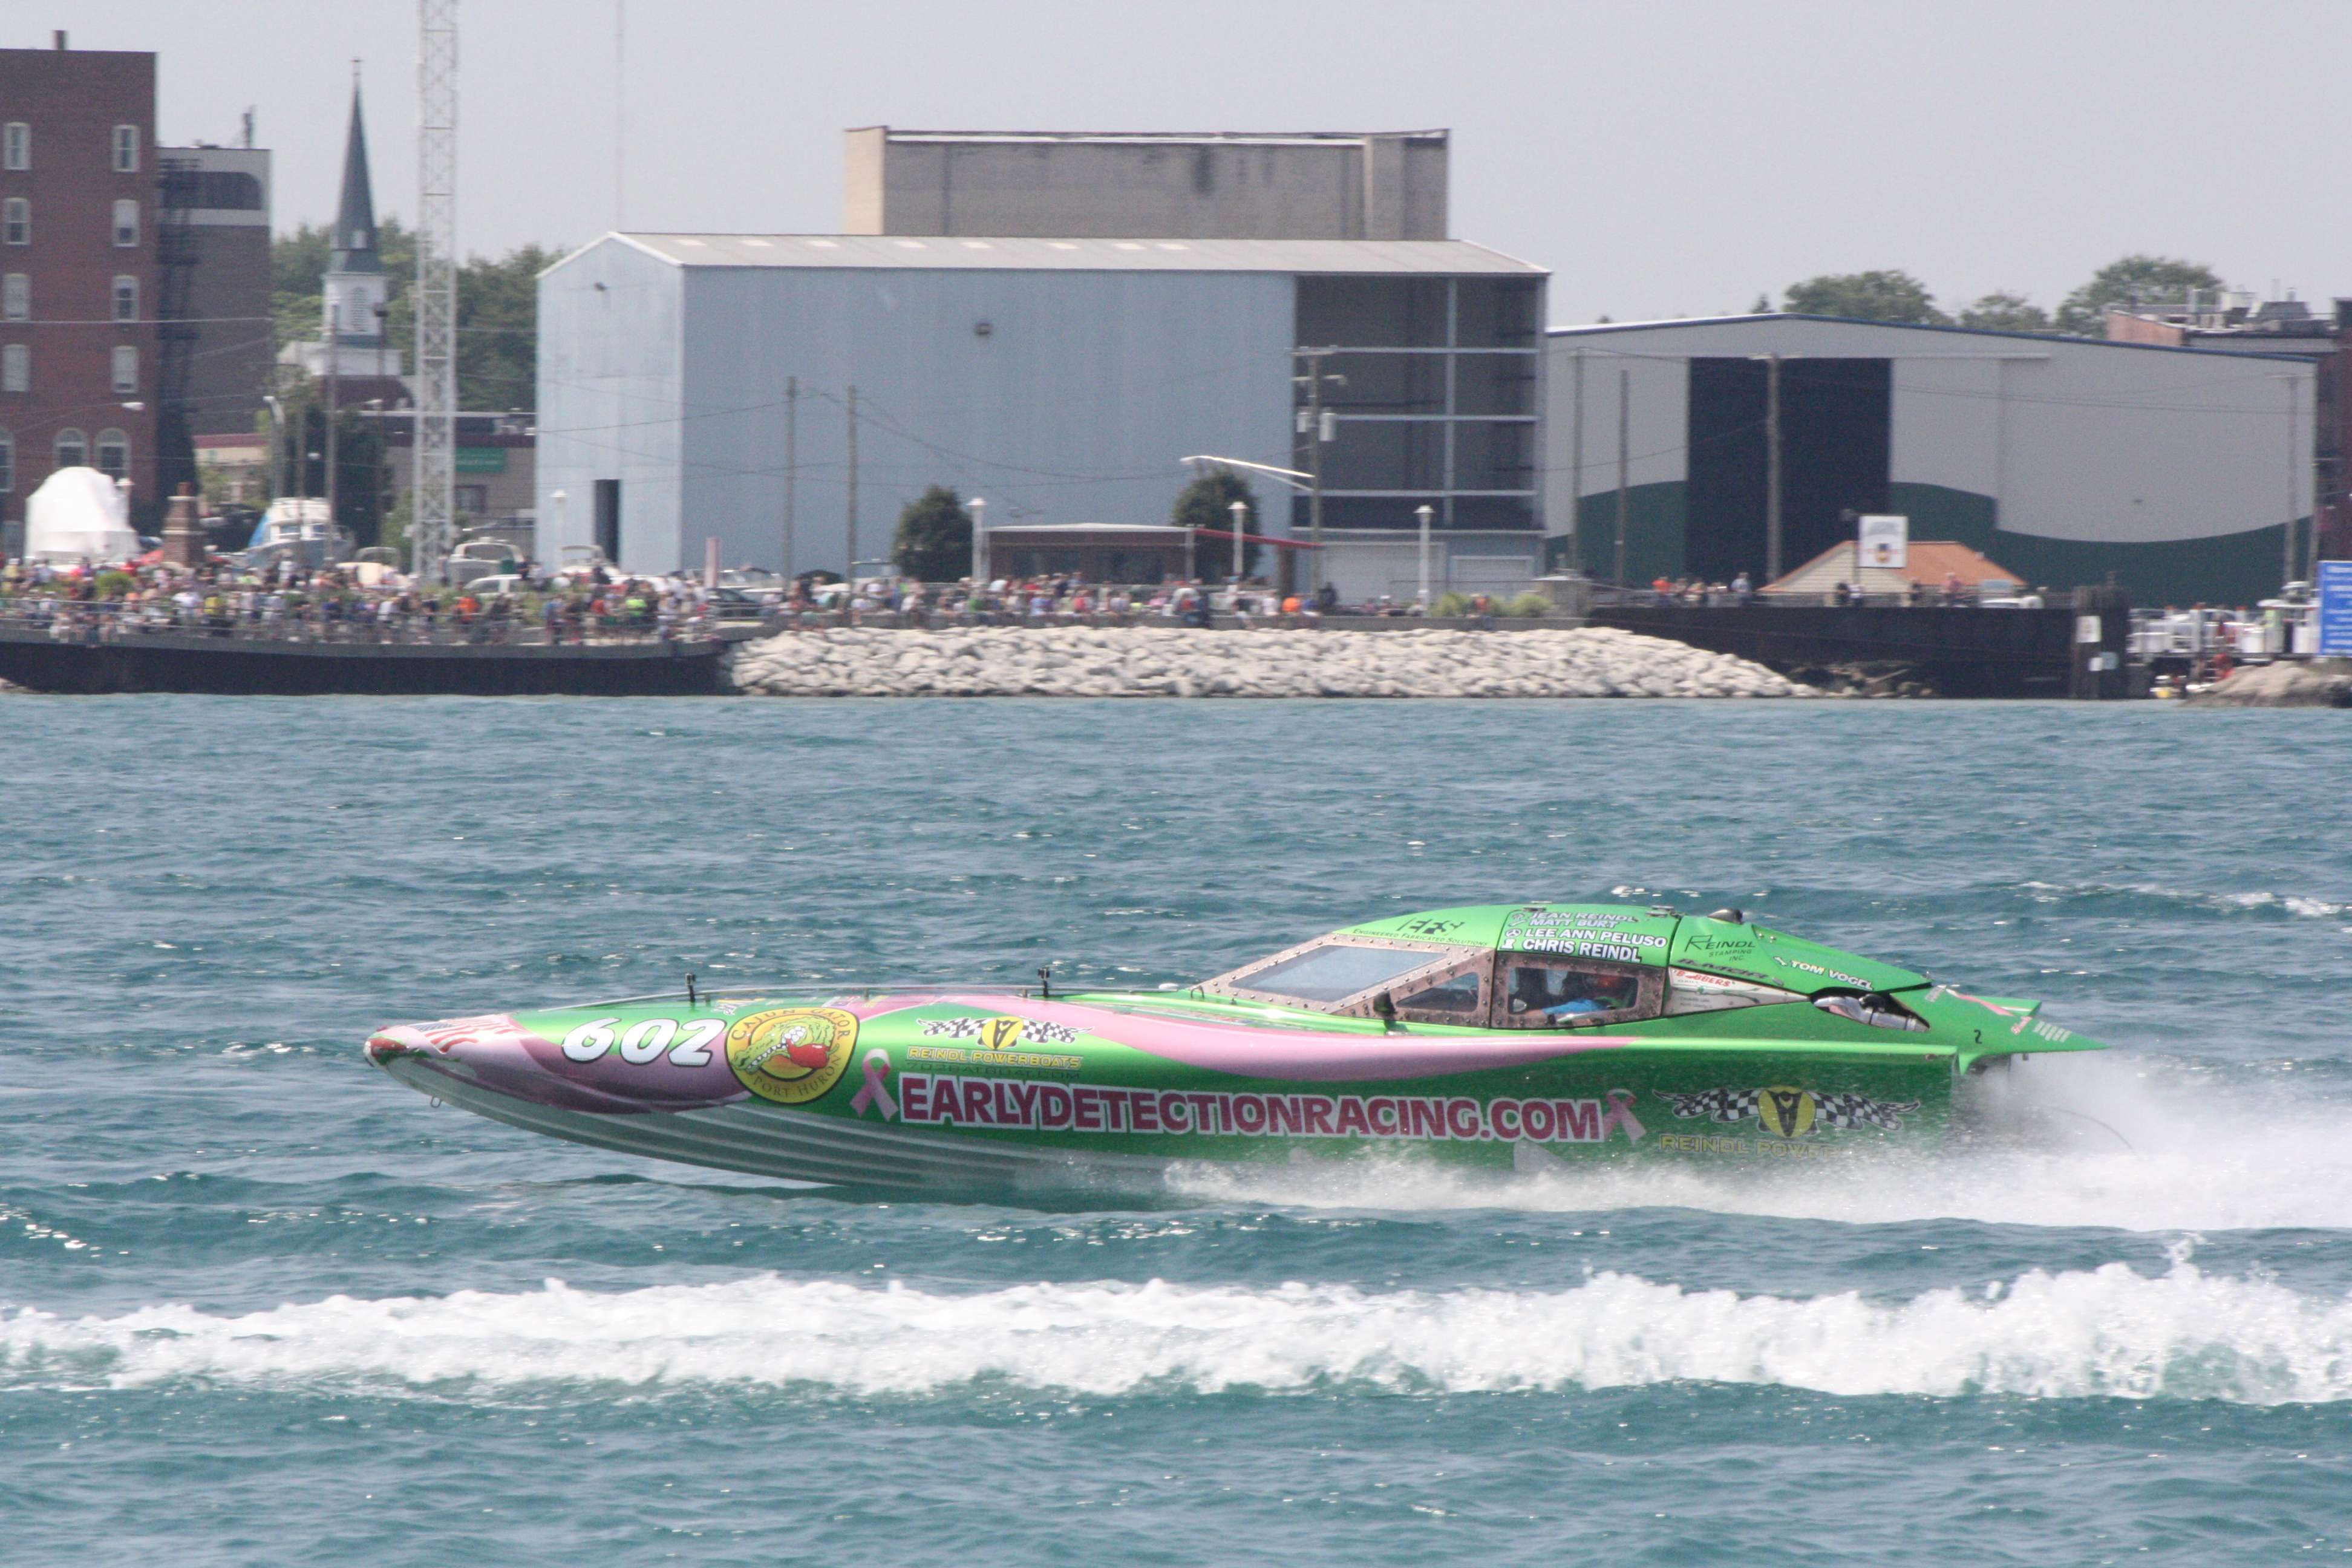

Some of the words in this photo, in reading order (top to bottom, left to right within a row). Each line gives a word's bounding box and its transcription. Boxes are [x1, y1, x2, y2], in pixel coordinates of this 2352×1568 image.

[1575, 912, 1638, 923] REINDL
[1576, 920, 1619, 929] BURT
[1521, 938, 1576, 955] CHRIS
[1579, 942, 1642, 962] REINDL
[1524, 929, 1557, 938] LEE
[1558, 929, 1596, 940] ANN
[1600, 931, 1667, 949] PELUSO
[1684, 935, 1756, 952] REINDL
[1708, 949, 1753, 958] STAMPING
[1791, 960, 1826, 975] TOM
[1828, 969, 1875, 991] VOGEL
[731, 1010, 795, 1040] CAJUN
[811, 1008, 851, 1040] GATOR
[561, 1017, 727, 1067] 602
[908, 1047, 968, 1063] REINDL
[971, 1050, 1083, 1070] POWERBOATS
[753, 1076, 789, 1097] PORT
[797, 1054, 841, 1096] HURON
[900, 1073, 1605, 1142] EARLYDETECTIONRACING.COM
[1659, 1134, 1750, 1155] REINDL
